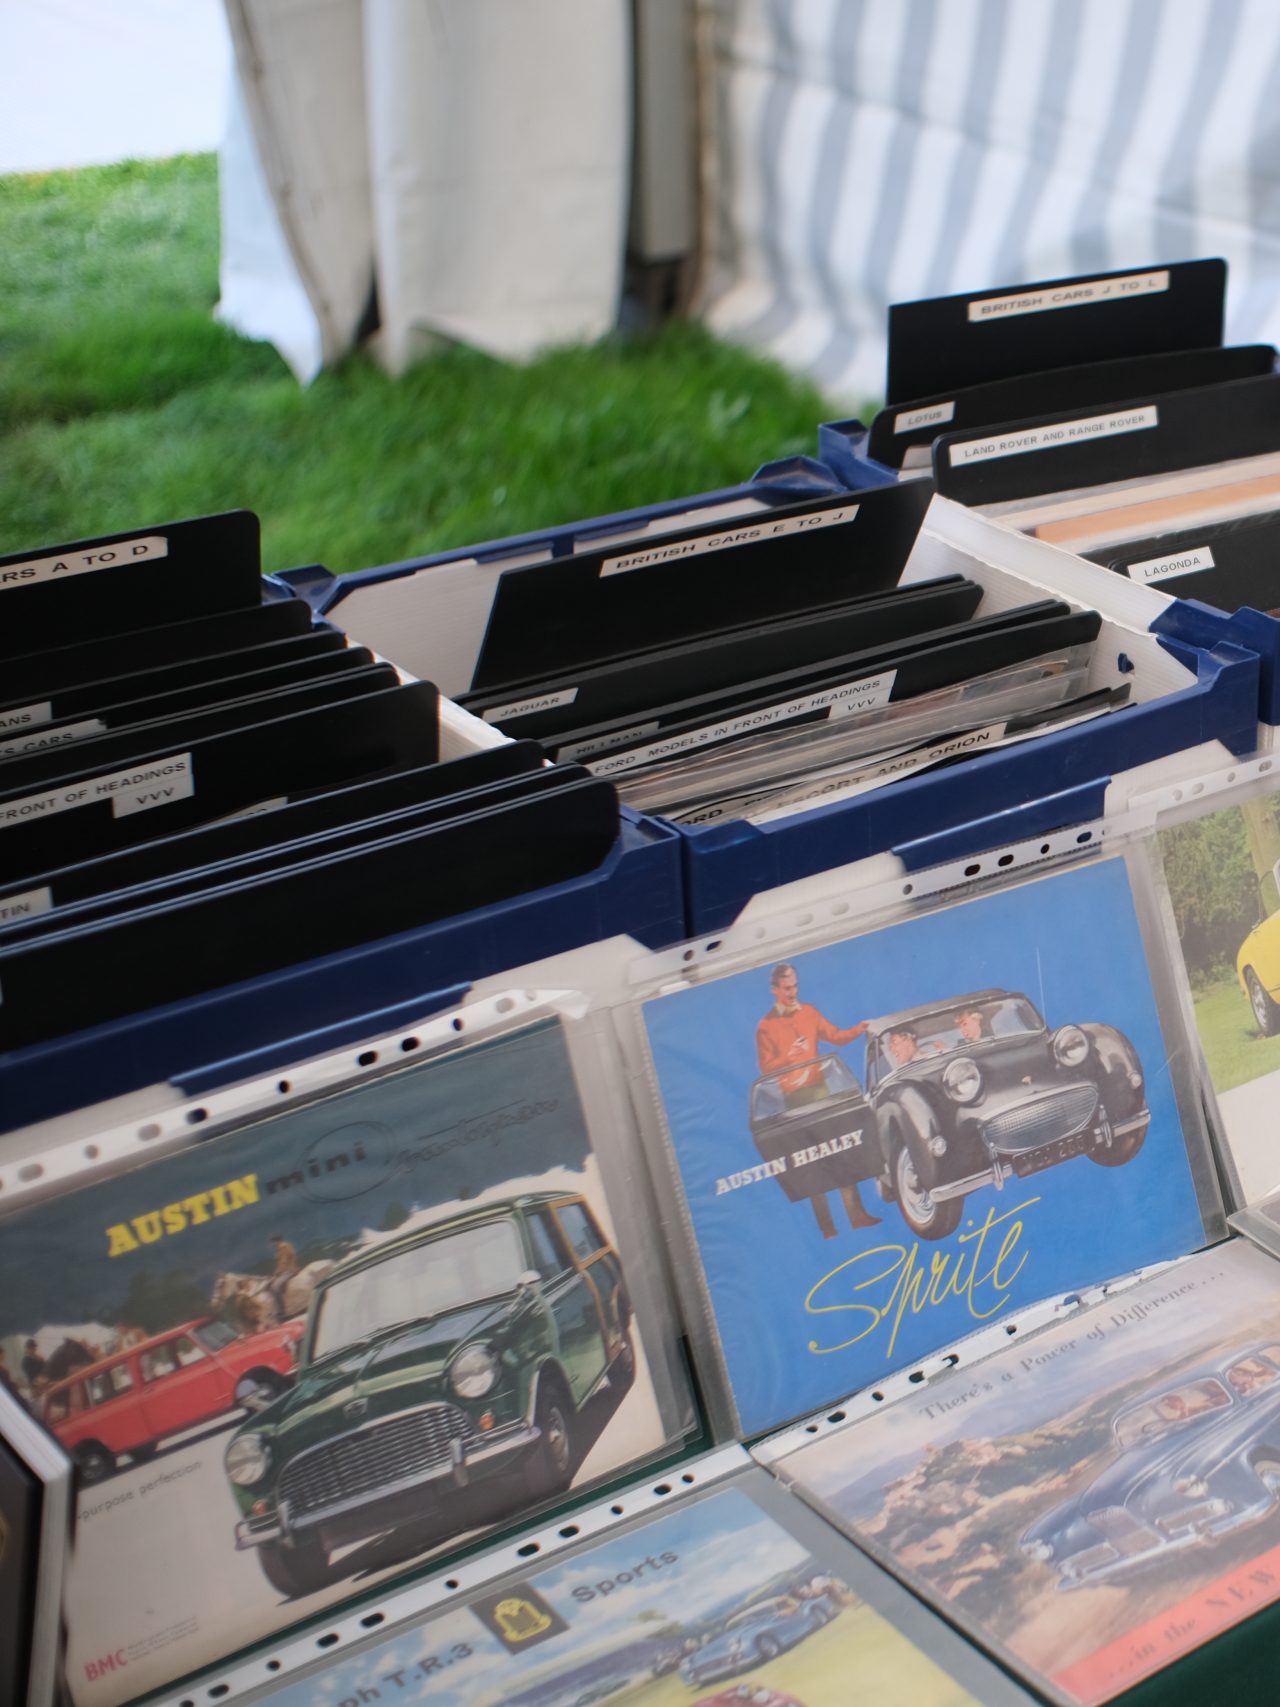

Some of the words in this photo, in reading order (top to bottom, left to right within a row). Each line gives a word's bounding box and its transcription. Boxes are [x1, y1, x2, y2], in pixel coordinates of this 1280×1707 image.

[980, 297, 1042, 315] BRITISH
[1051, 288, 1094, 302] CARS
[1103, 285, 1111, 294] J
[1119, 281, 1140, 291] TO
[1148, 279, 1158, 288] L
[907, 410, 943, 425] LOTUS
[965, 444, 996, 457] LAND
[1000, 435, 1037, 450] ROVER
[1043, 430, 1064, 442] AND
[1069, 422, 1105, 436] RANGE
[1110, 414, 1145, 428] ROVER
[615, 544, 696, 569] BRITISH
[707, 530, 761, 547] CARS
[772, 524, 785, 534] E
[799, 516, 822, 528] TO
[832, 512, 844, 521] J
[0, 568, 36, 584] RS
[52, 562, 69, 573] A
[83, 552, 116, 566] TO
[132, 545, 148, 556] D
[1144, 557, 1201, 577] LAGONDA
[500, 696, 560, 717] JAGUAR
[847, 697, 877, 711] VVV
[594, 755, 636, 774] FORD
[647, 732, 708, 757] MODELS
[714, 726, 728, 738] IN
[733, 710, 781, 732] FRONT
[786, 702, 808, 715] OF
[810, 680, 881, 707] HEADINGS
[877, 757, 918, 778] AND
[928, 732, 991, 760] ORION
[65, 789, 88, 803] OF
[96, 762, 187, 793] HEADINGS
[136, 787, 175, 805] VVV
[715, 1156, 787, 1196] AUSTIN
[791, 1129, 864, 1168] HEALEY
[106, 1173, 261, 1258] AUSTIN
[264, 1140, 367, 1196] mini
[805, 1196, 1041, 1359] Sprite
[919, 1382, 994, 1421] There's
[1001, 1371, 1014, 1382] a
[1020, 1339, 1078, 1373] Power
[1086, 1323, 1105, 1341] of
[139, 1461, 203, 1496] perfection
[570, 1550, 679, 1604] Sports
[1164, 1614, 1196, 1641] the
[1205, 1567, 1276, 1610] NEW
[84, 1648, 128, 1682] BMC
